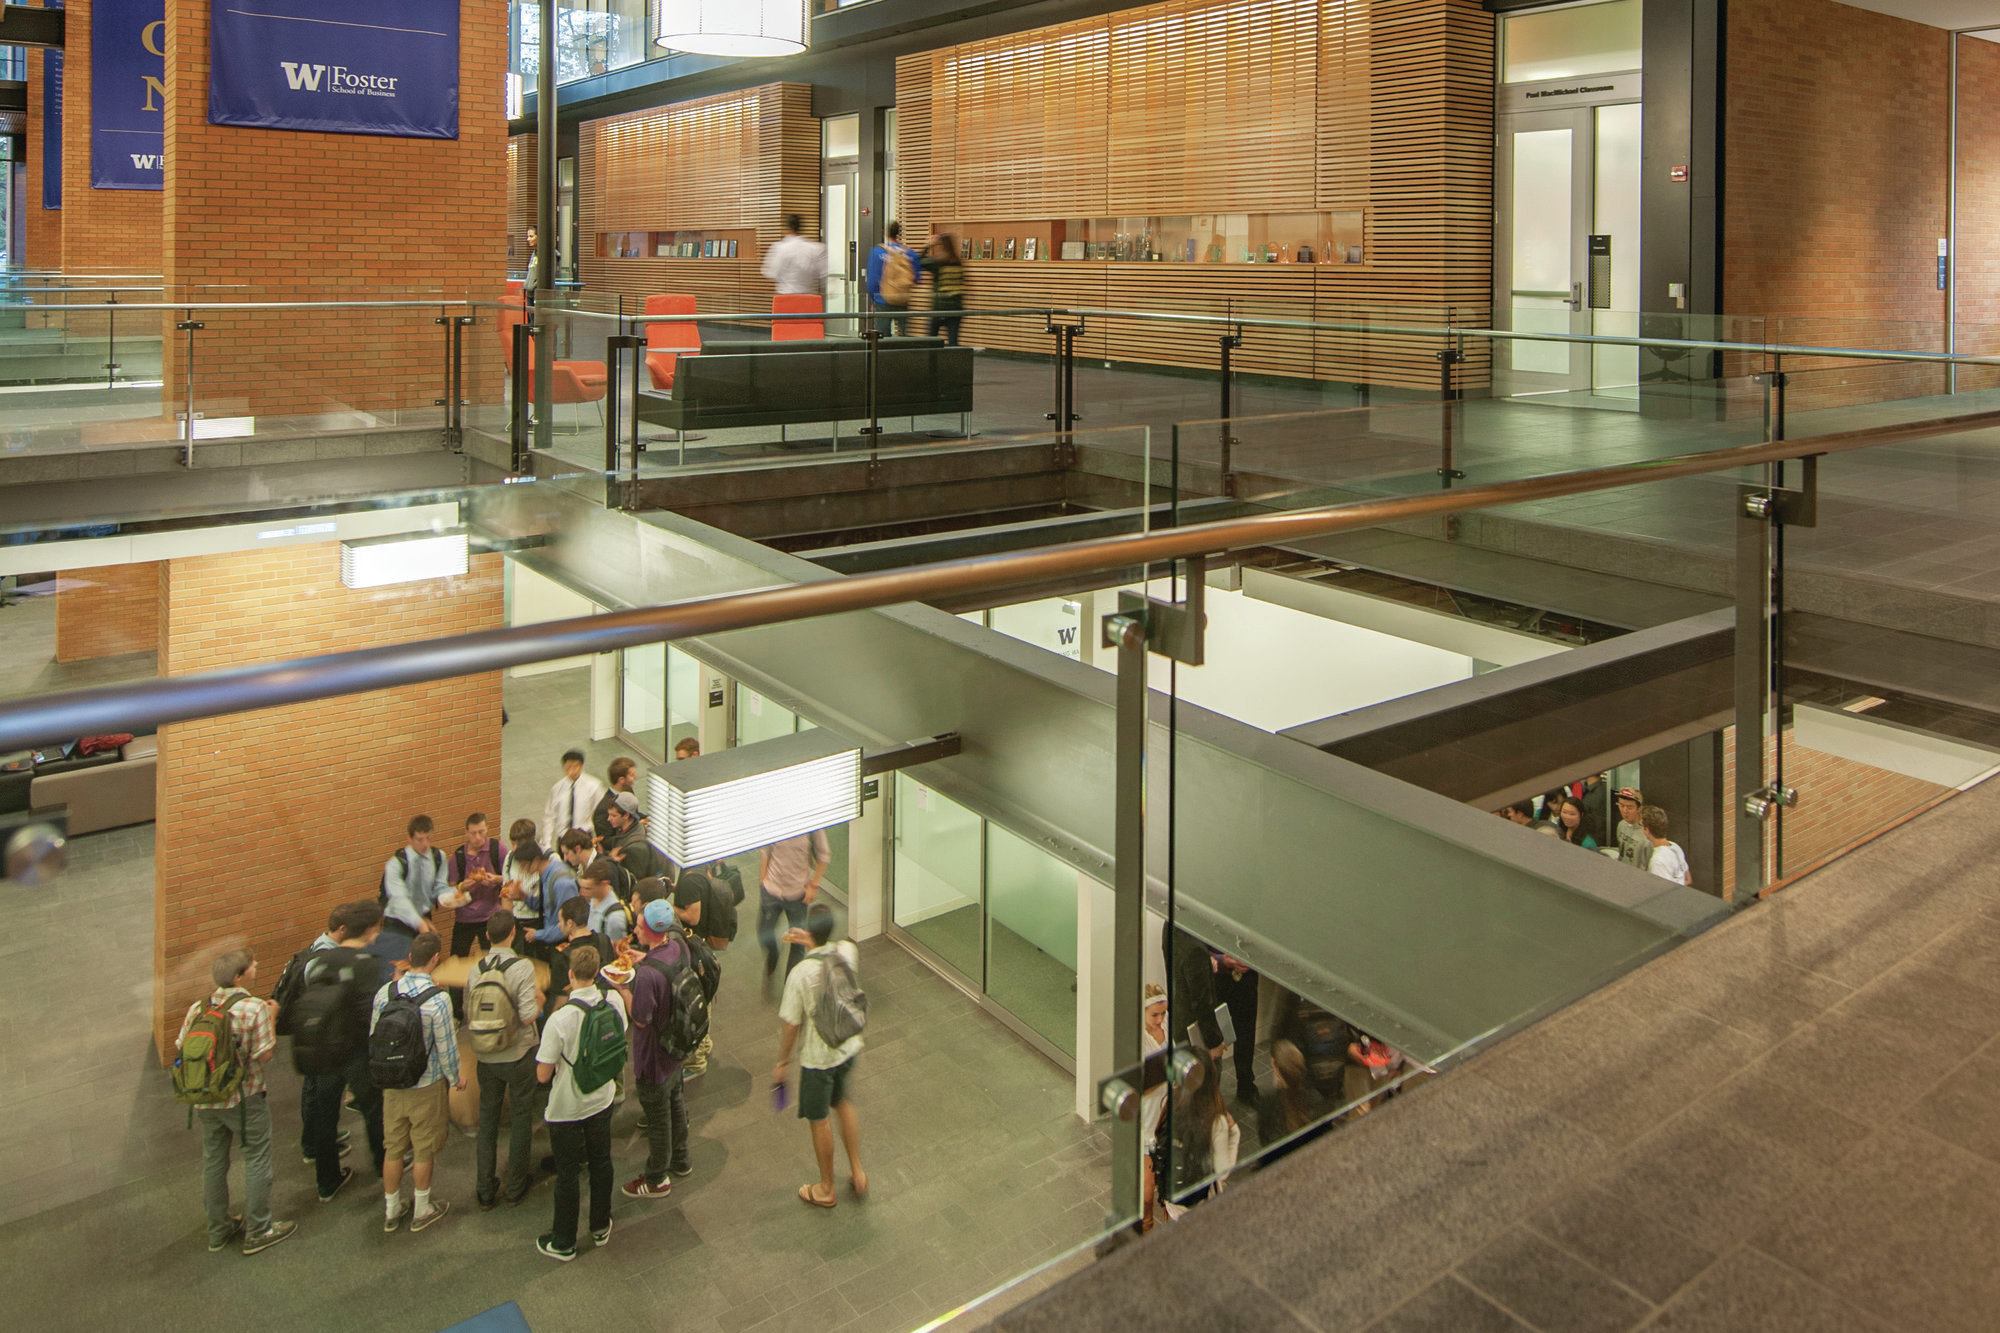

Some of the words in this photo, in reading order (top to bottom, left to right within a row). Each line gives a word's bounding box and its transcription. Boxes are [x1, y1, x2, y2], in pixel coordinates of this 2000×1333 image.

[281, 61, 326, 91] W
[332, 66, 398, 90] Foster
[332, 86, 356, 95] School
[367, 89, 396, 97] Business
[130, 154, 156, 169] W
[1058, 627, 1077, 645] W
